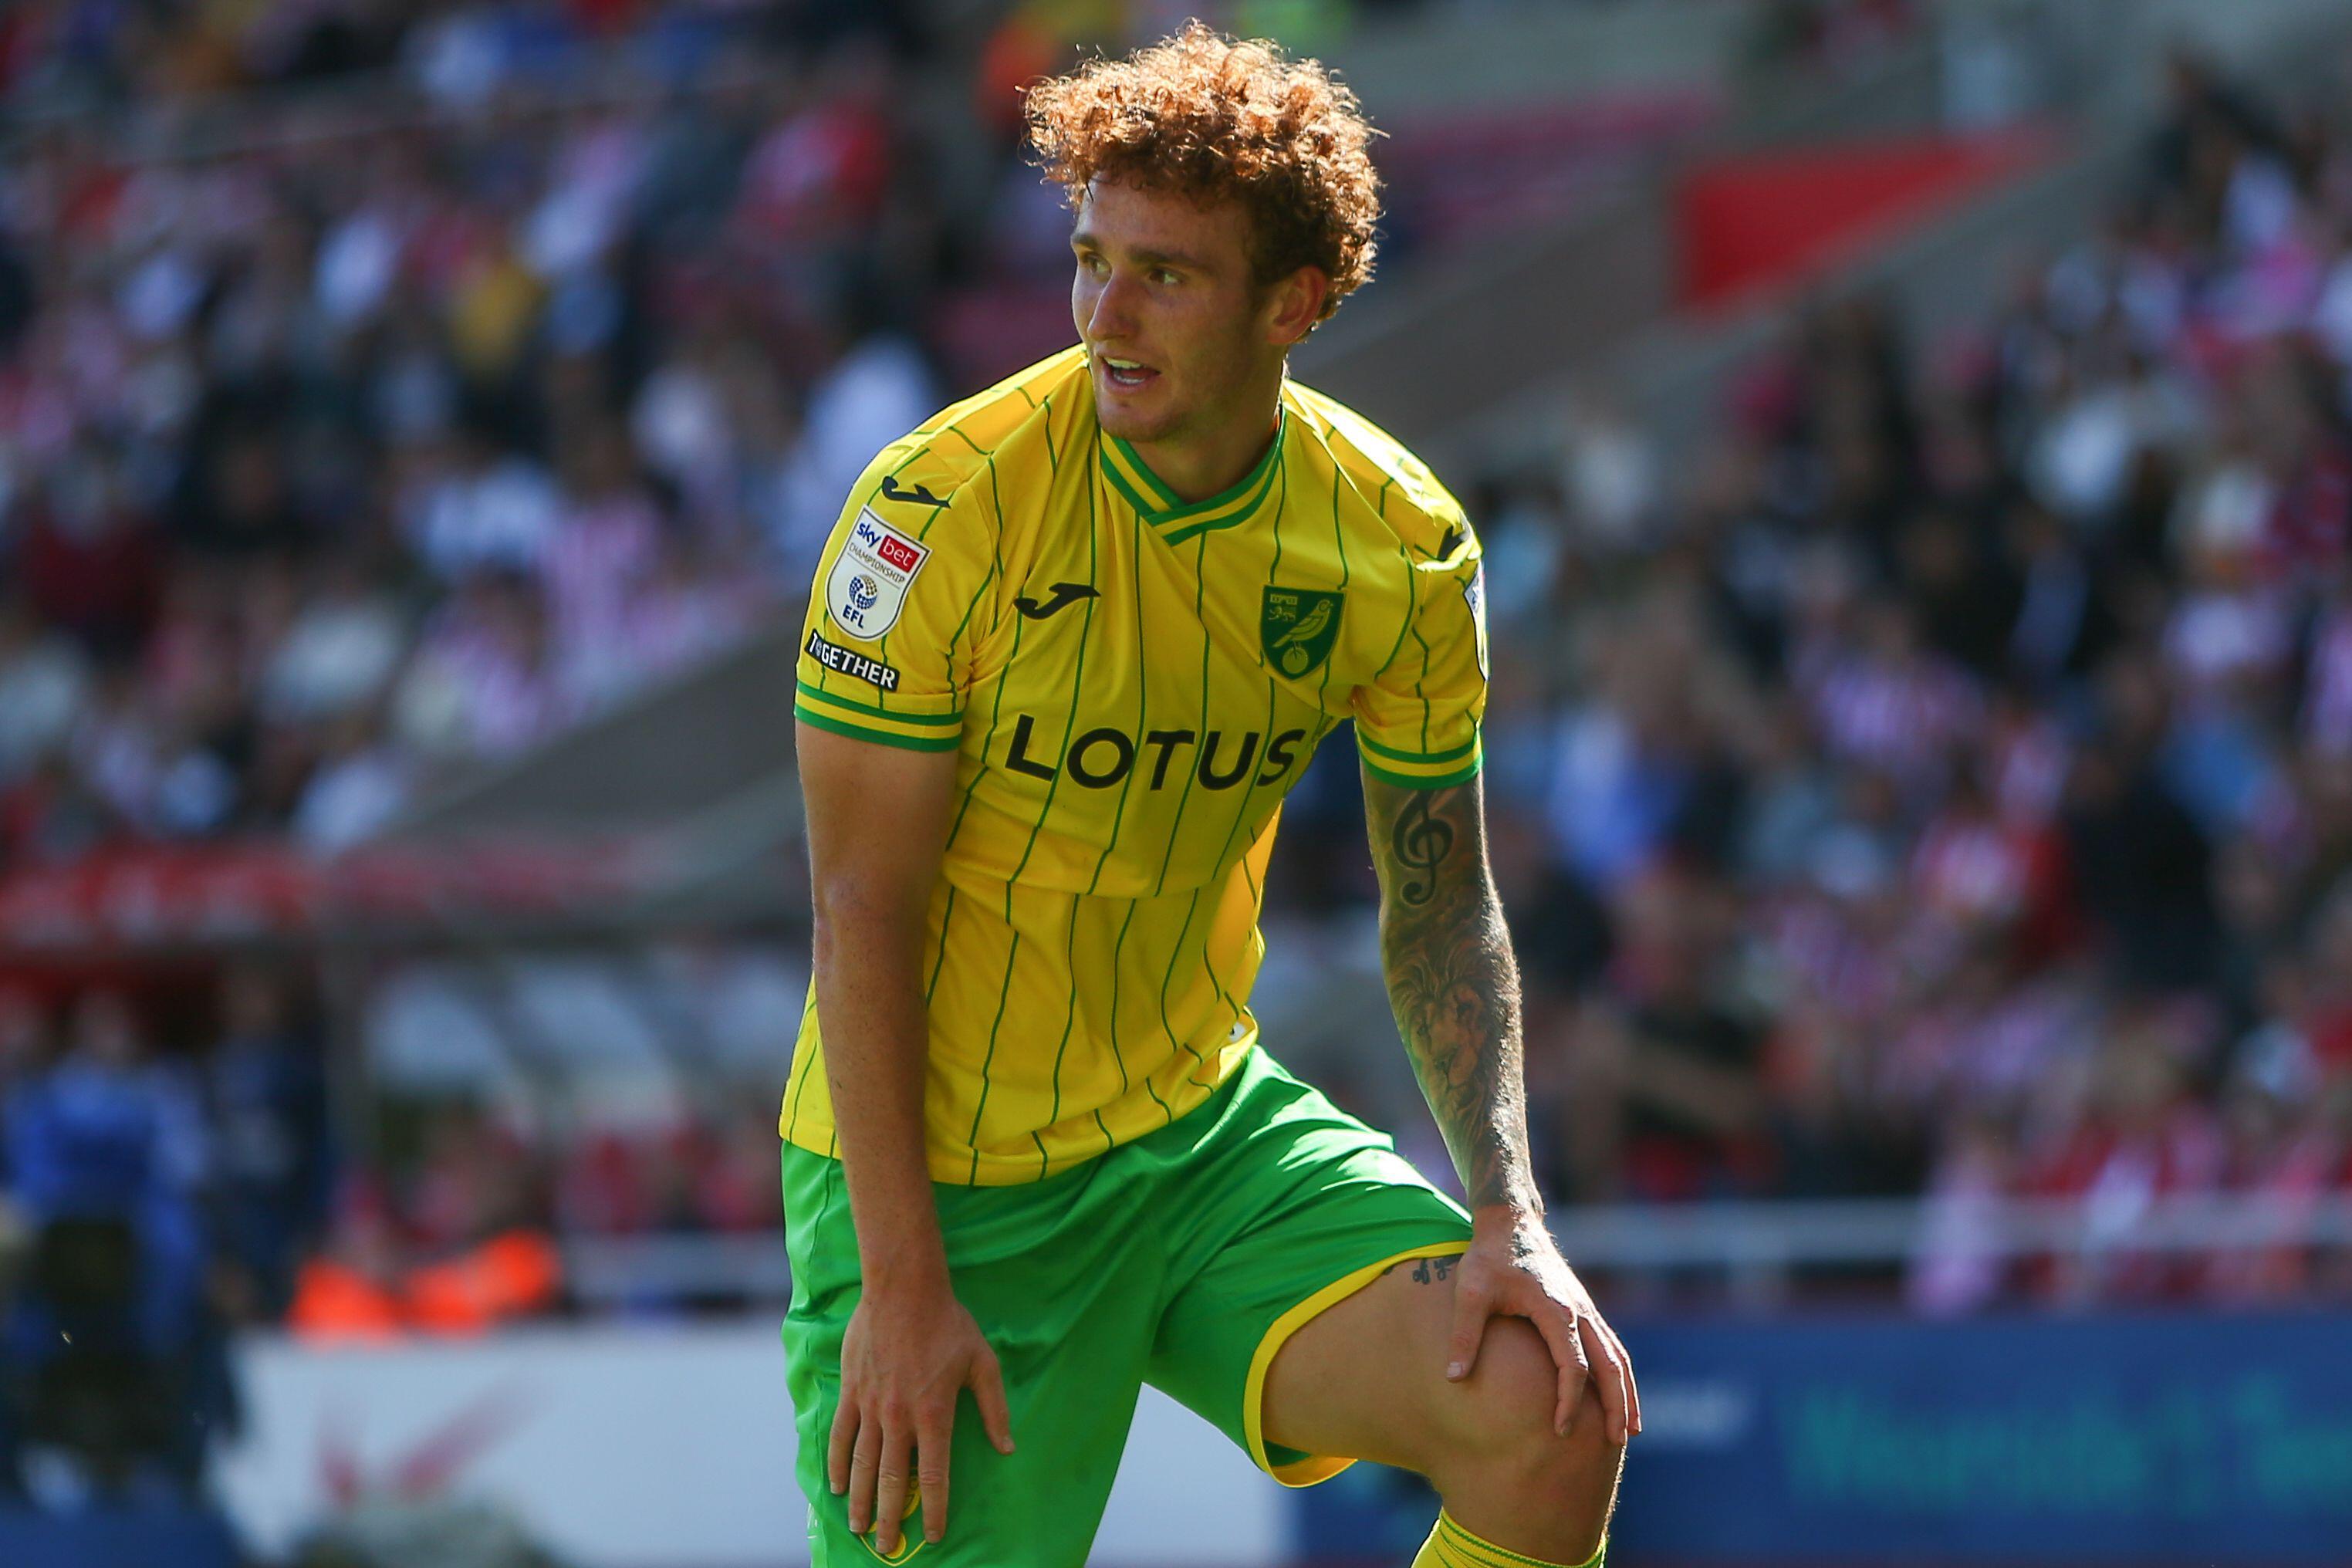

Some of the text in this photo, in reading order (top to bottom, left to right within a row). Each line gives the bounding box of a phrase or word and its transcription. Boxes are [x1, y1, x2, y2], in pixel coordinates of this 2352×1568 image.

[849, 542, 905, 583] CHAMPIONSHIP
[857, 522, 912, 566] sky bet
[843, 605, 864, 628] EFL
[809, 633, 896, 688] TOGETHER
[1005, 714, 1306, 791] LOTUS
